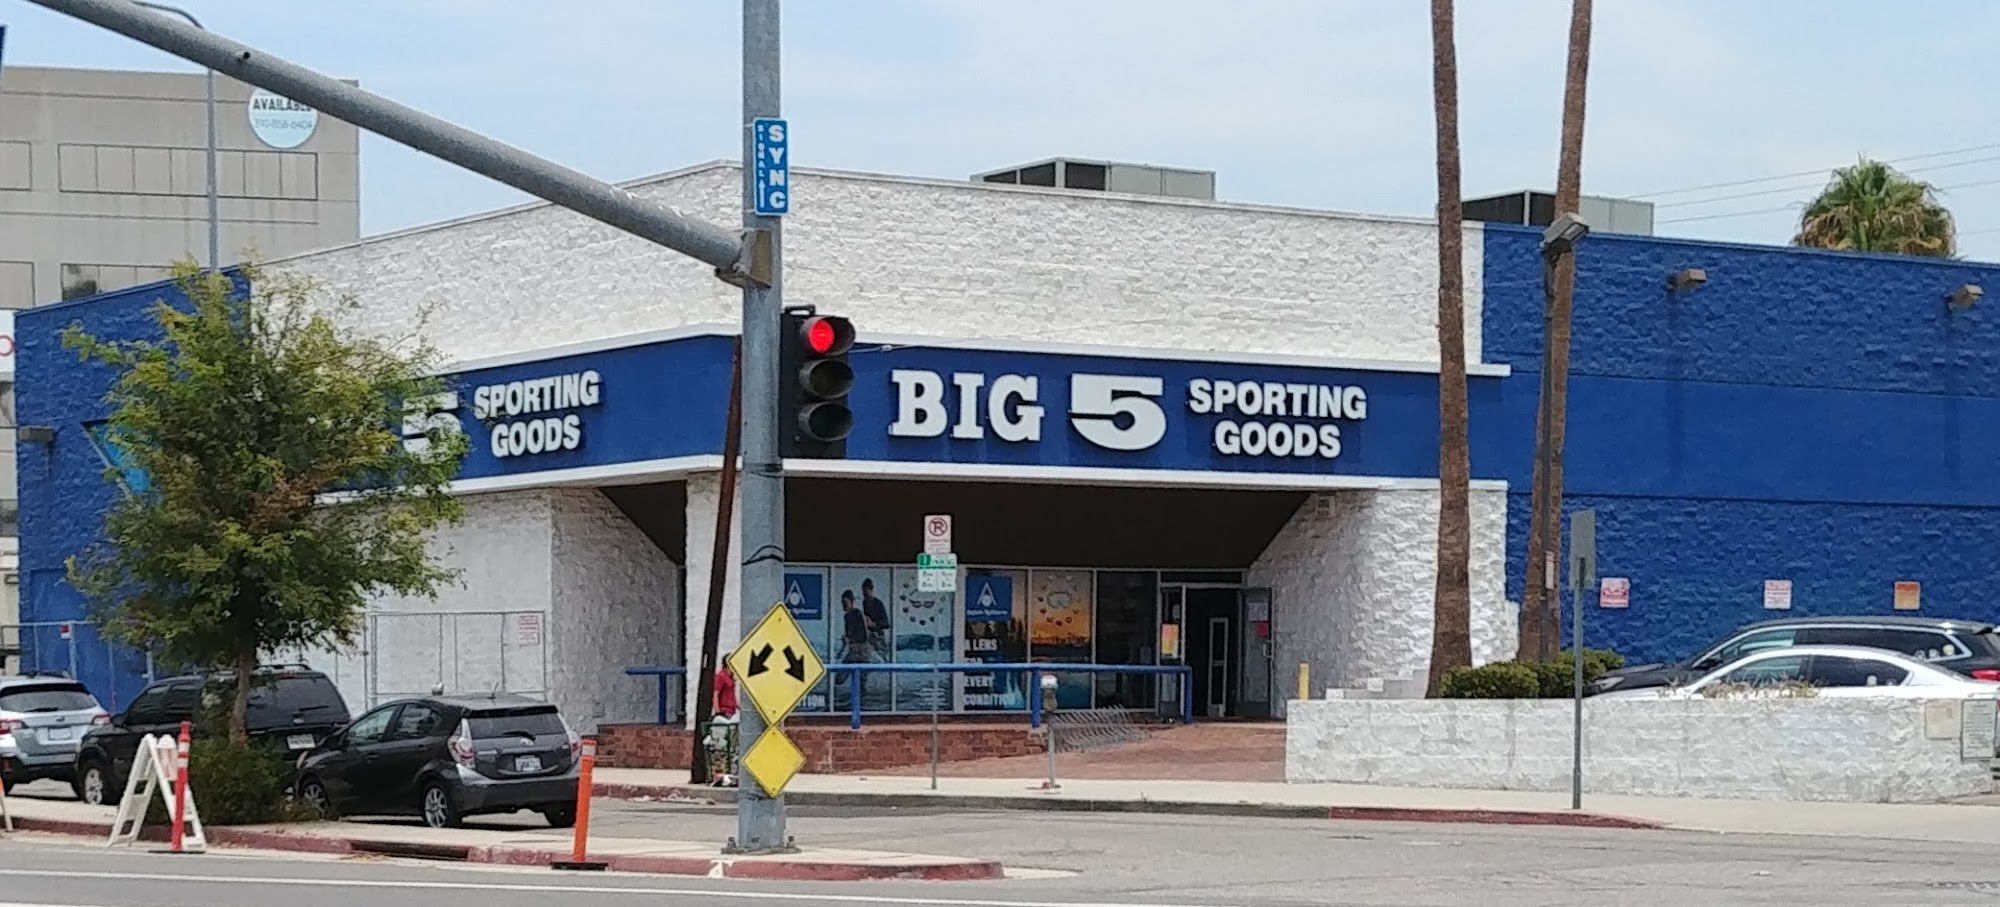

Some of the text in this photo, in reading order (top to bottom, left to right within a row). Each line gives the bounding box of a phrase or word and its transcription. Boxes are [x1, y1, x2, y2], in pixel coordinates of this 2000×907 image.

[253, 98, 311, 111] AVAILAB
[768, 124, 786, 208] SYNC
[474, 370, 600, 420] SPORTING
[888, 369, 1167, 450] BIG 5
[1189, 378, 1367, 420] SPORTING
[491, 414, 581, 458] GOODS
[1214, 420, 1341, 458] GOODS
[973, 638, 998, 651] LENS
